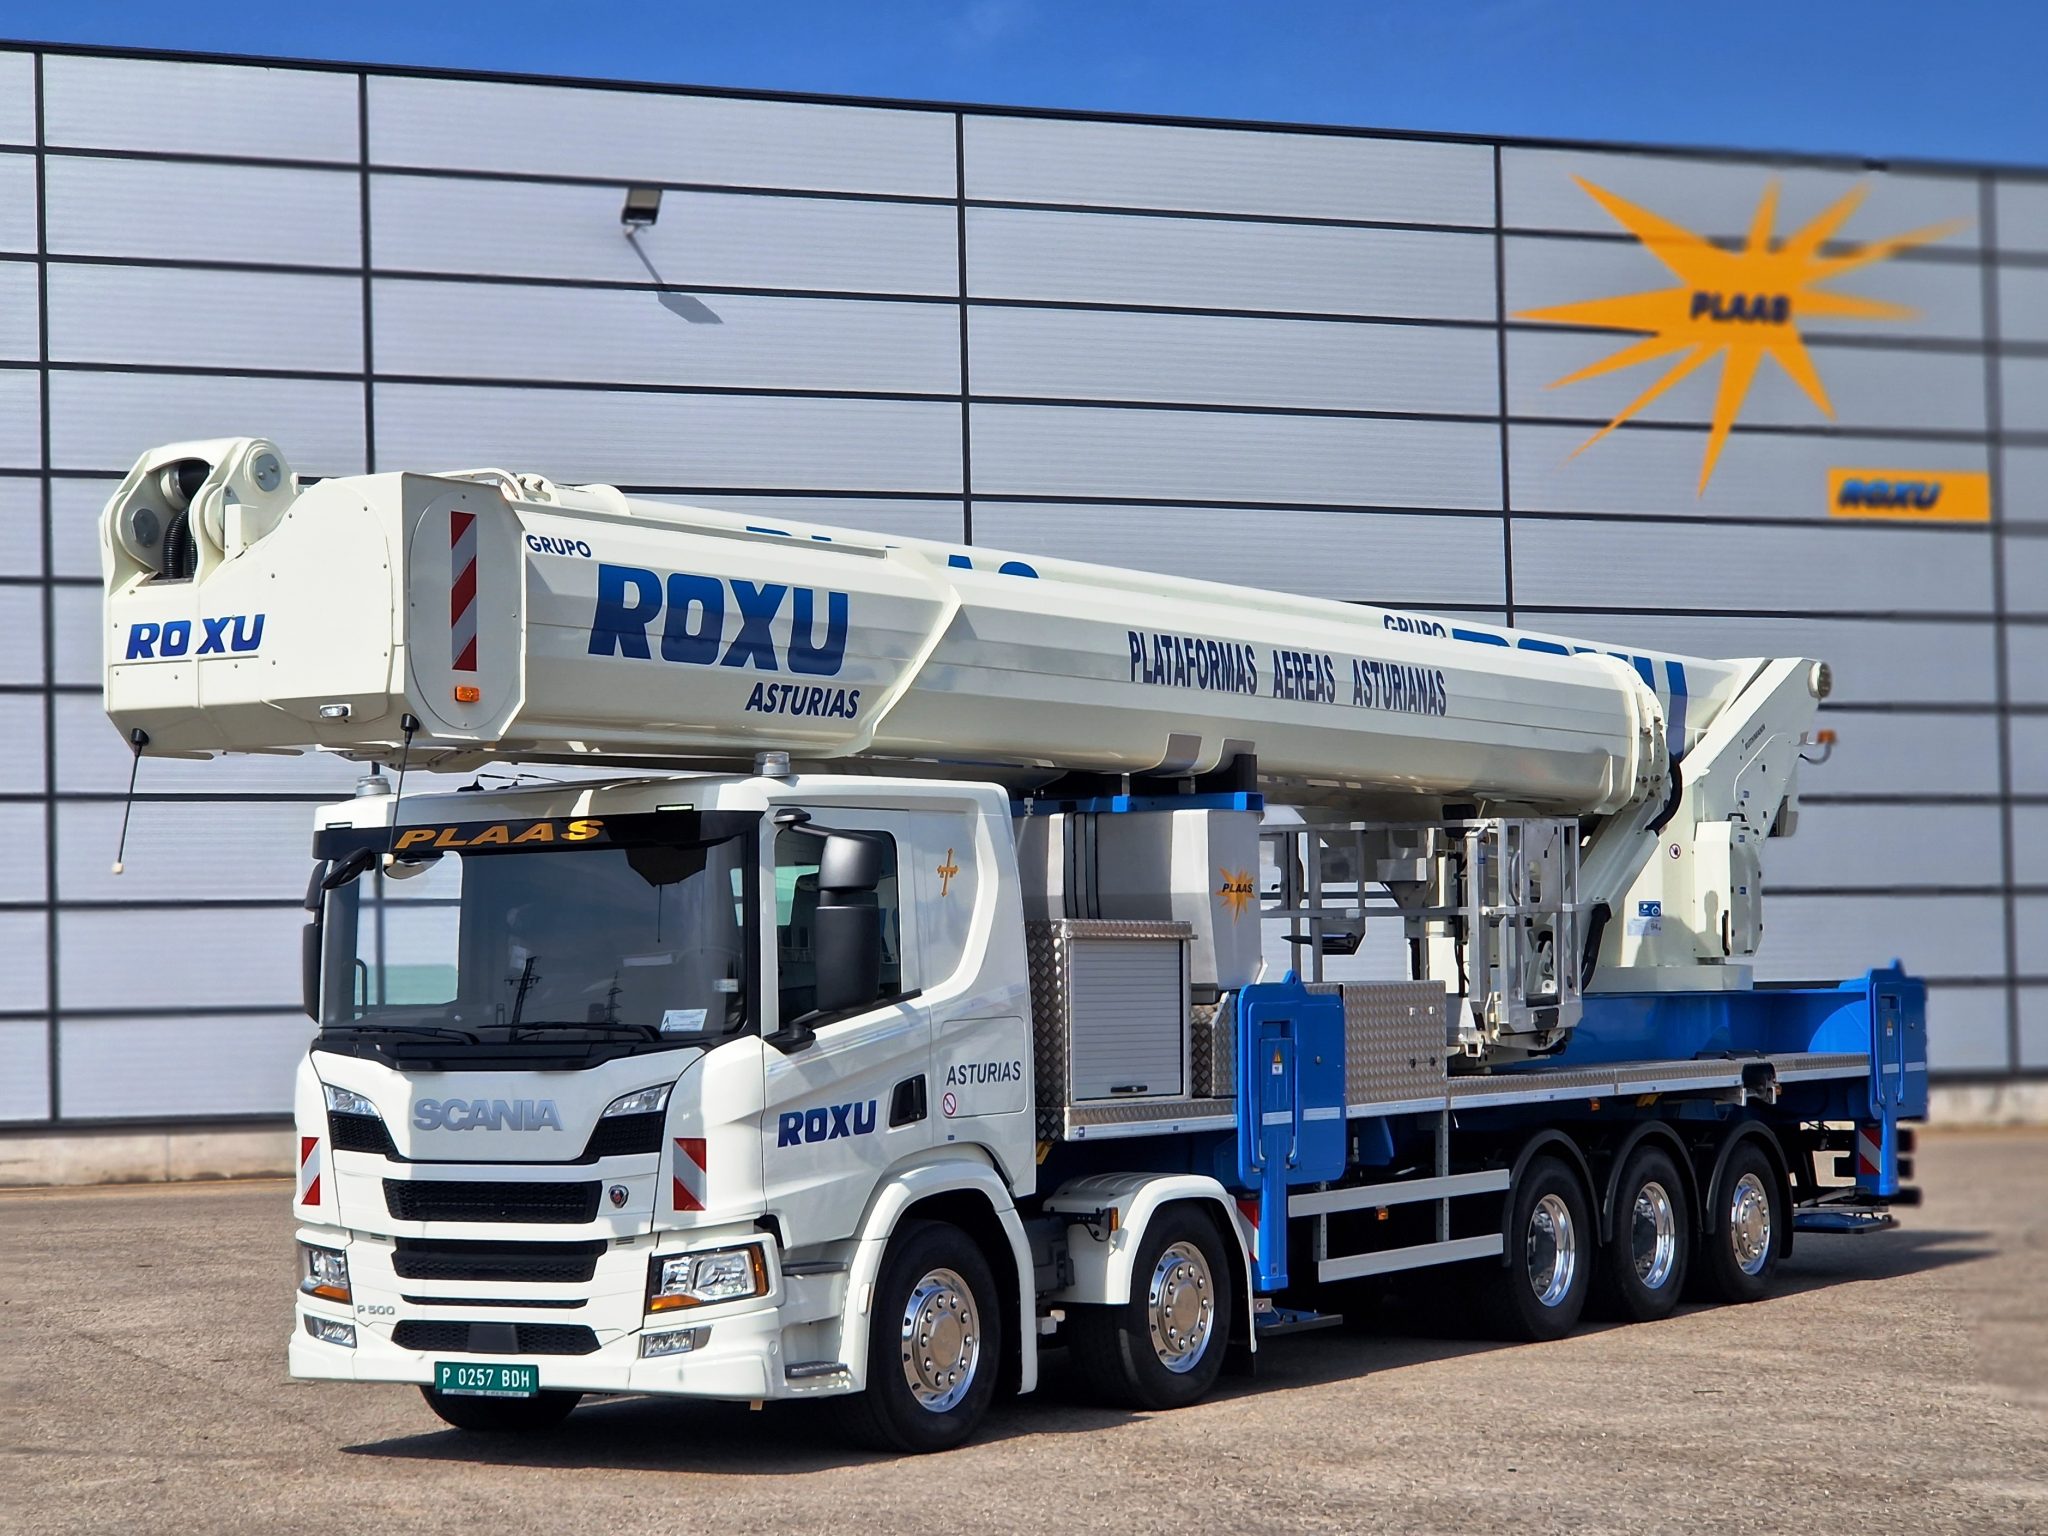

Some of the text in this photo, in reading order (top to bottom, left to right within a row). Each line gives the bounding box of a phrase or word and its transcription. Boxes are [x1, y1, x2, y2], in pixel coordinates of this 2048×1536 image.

[1839, 480, 1941, 510] ROXU
[526, 535, 592, 558] GRUPO
[588, 563, 848, 676] ROXU
[126, 614, 265, 660] ROXU
[1128, 631, 1257, 695] PLATAFORMAS
[1273, 650, 1335, 704] AEREAS
[1352, 659, 1447, 716] ASTURIANAS
[745, 682, 860, 719] ASTURIAS
[394, 820, 604, 849] PLAAS
[1222, 883, 1253, 893] PLAAS
[946, 1060, 1021, 1086] ASTURIAS
[413, 1098, 562, 1132] SCANIA
[777, 1100, 876, 1148] ROXU
[357, 1305, 395, 1315] P 500
[443, 1367, 530, 1388] P 0257 BDH
